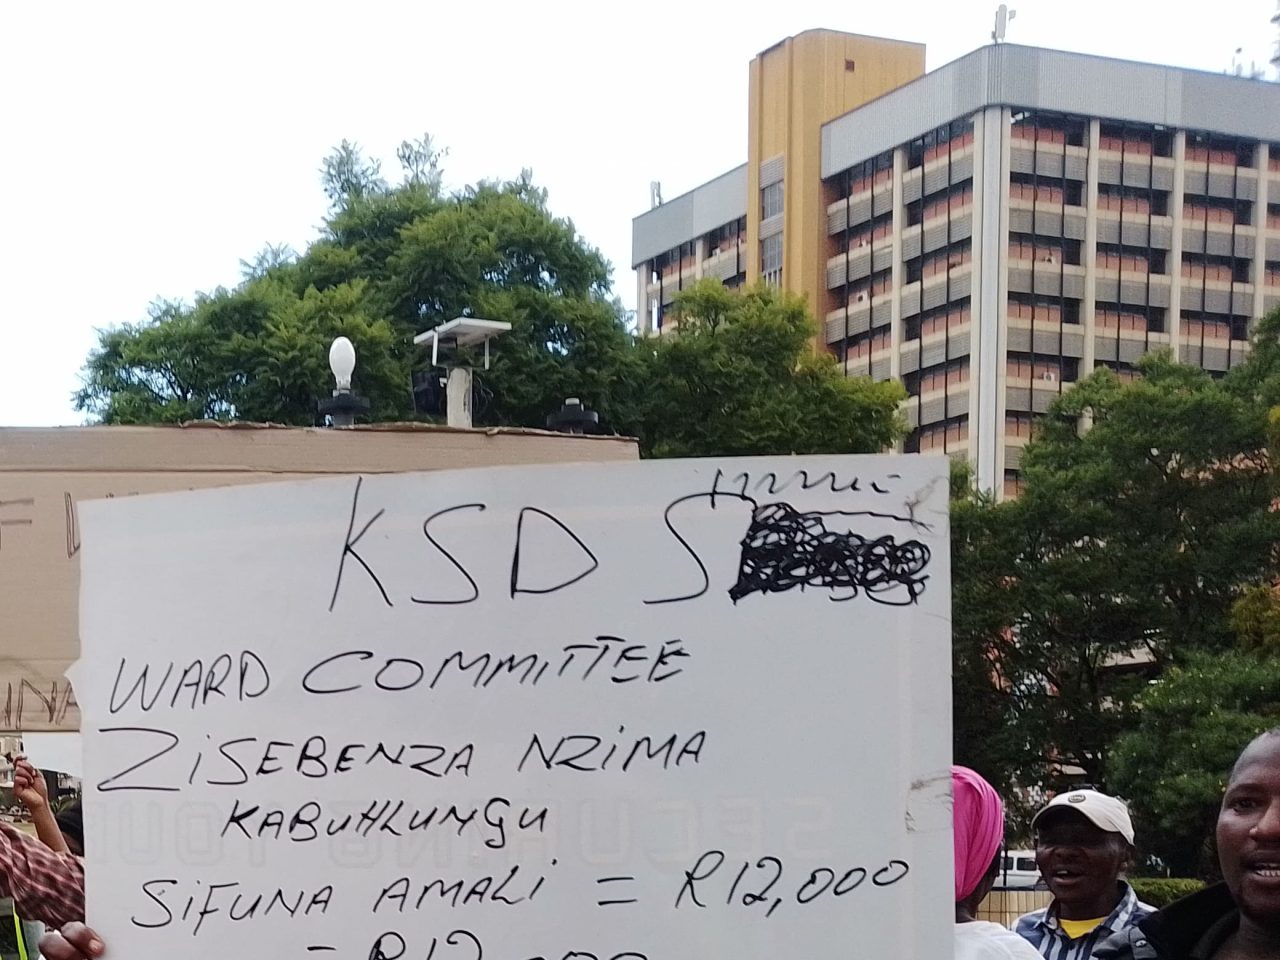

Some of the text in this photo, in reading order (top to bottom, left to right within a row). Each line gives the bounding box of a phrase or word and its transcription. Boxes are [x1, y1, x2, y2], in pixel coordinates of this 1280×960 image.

[328, 475, 599, 612] KSD
[109, 635, 691, 715] WARD COMMITTEE
[674, 849, 910, 918] R12,000
